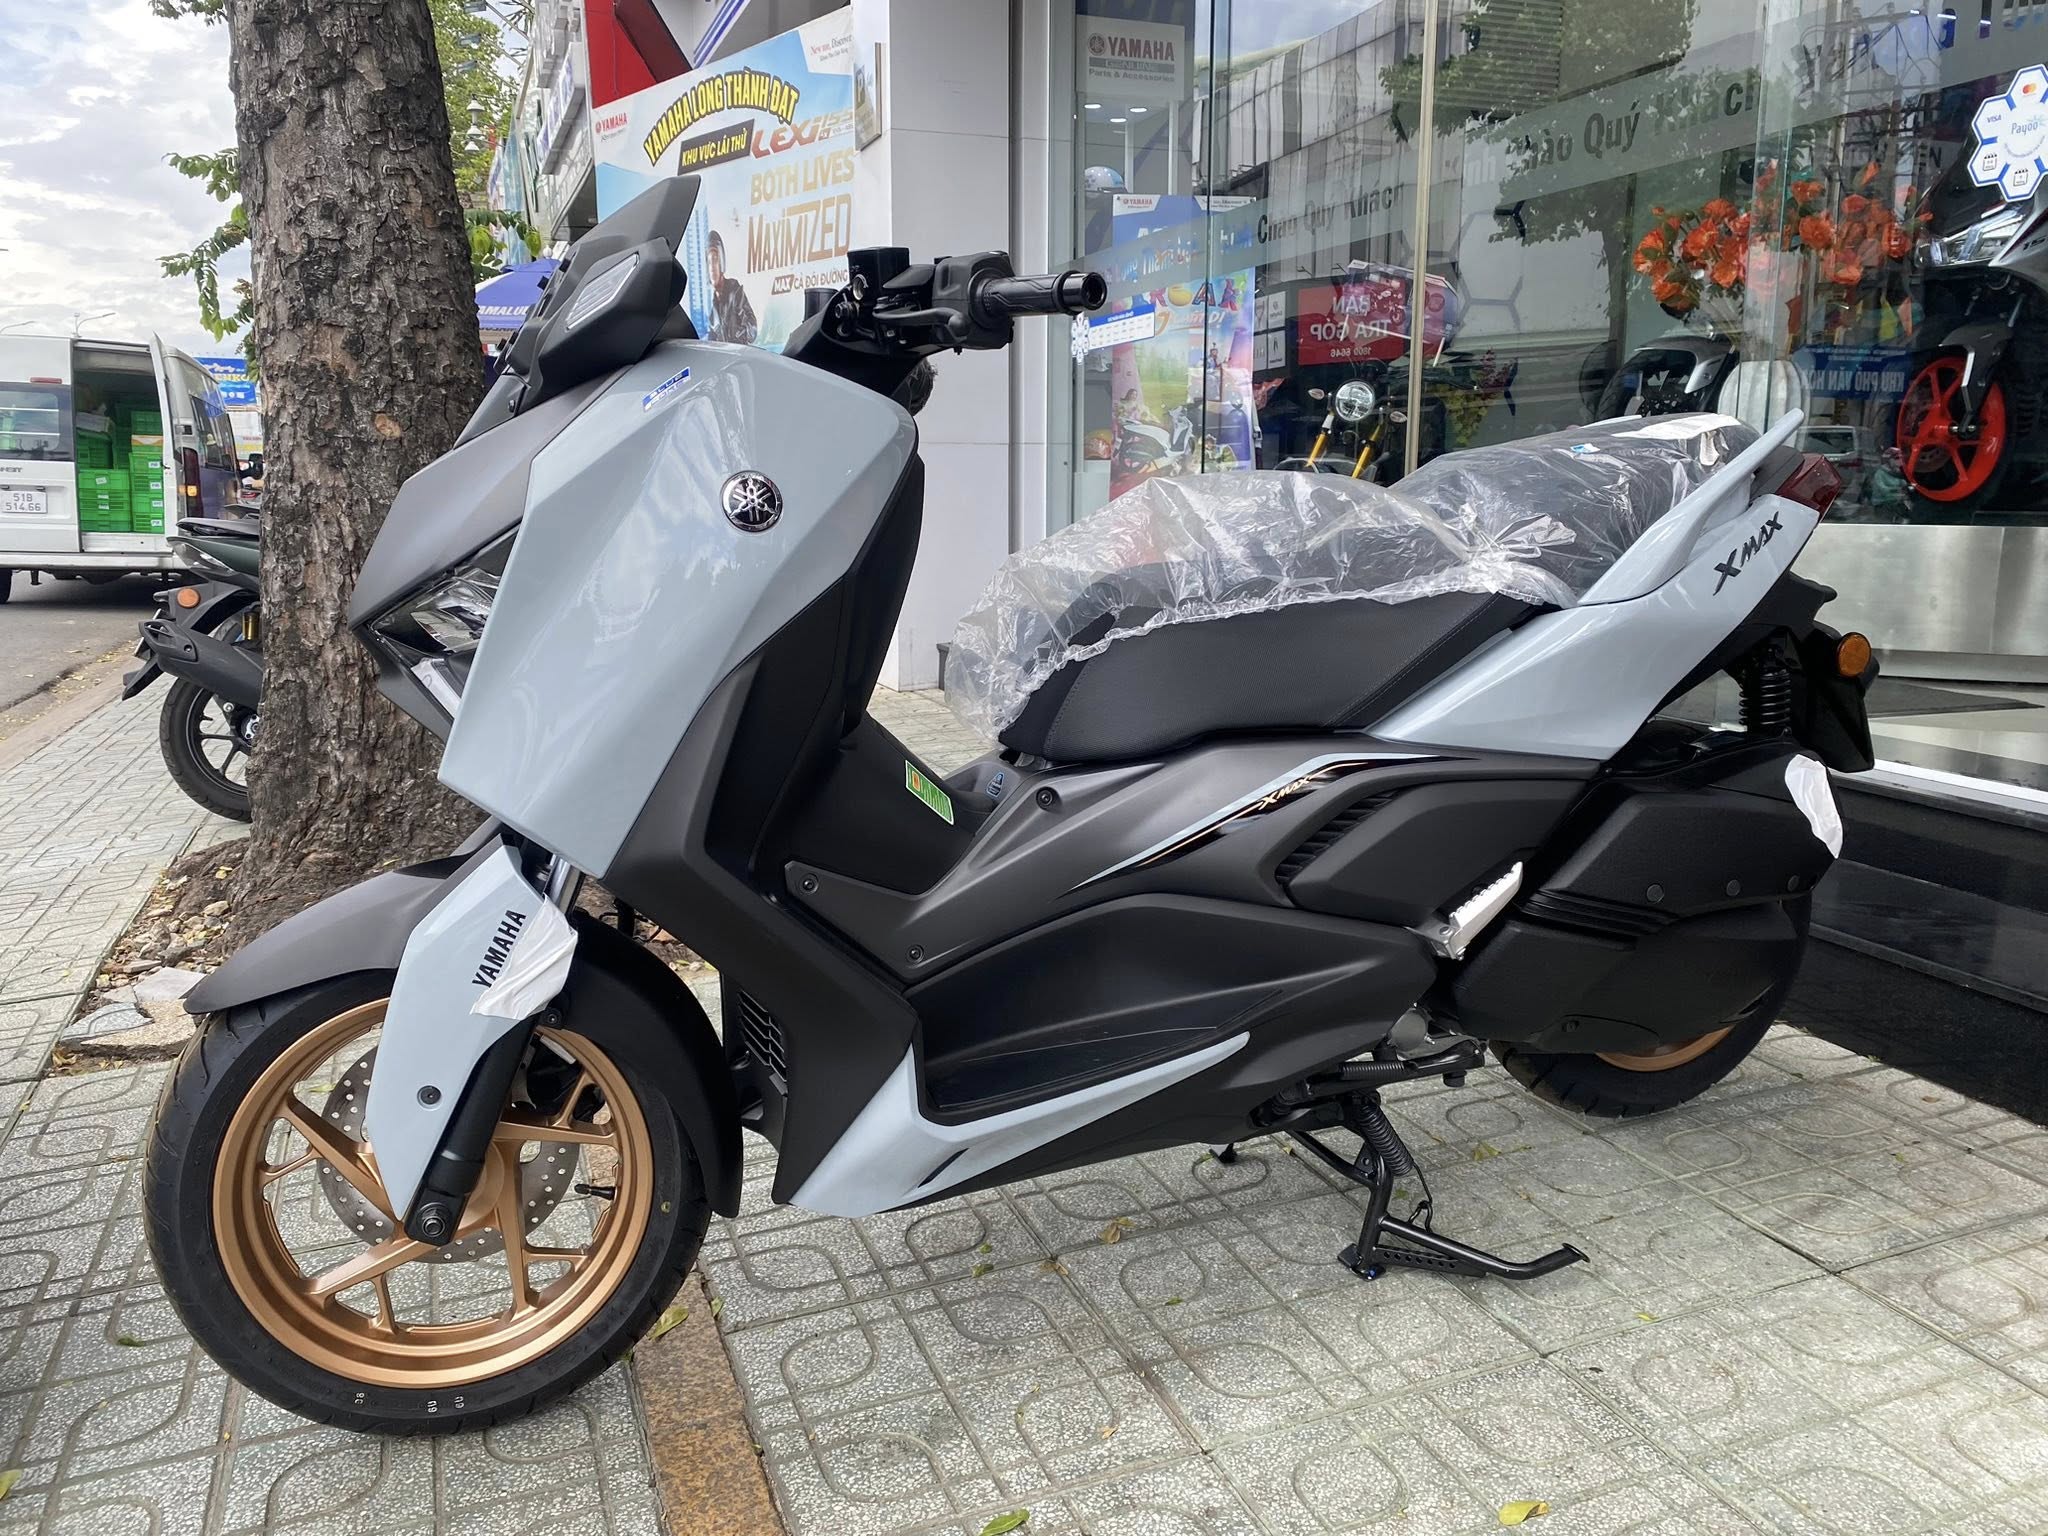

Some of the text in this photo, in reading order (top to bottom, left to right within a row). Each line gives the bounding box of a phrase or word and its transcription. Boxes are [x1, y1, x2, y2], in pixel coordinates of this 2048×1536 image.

[1108, 36, 1175, 62] YAMAHA
[1089, 68, 1175, 83] Parts & Accessories
[600, 112, 628, 132] YAMAHA
[644, 67, 800, 166] YAMAHA LONG THÀNH ĐẠT
[1583, 100, 1641, 158] Quý
[2011, 121, 2038, 136] Payoo
[681, 127, 748, 167] KHU VỰC LÁI THỬ
[751, 148, 855, 206] BOTH LIVES
[774, 275, 793, 292] MAX
[5, 502, 42, 512] 514.66
[13, 492, 33, 502] 51B
[1258, 776, 1310, 811] XMAX
[471, 909, 527, 989] YAMAHA
